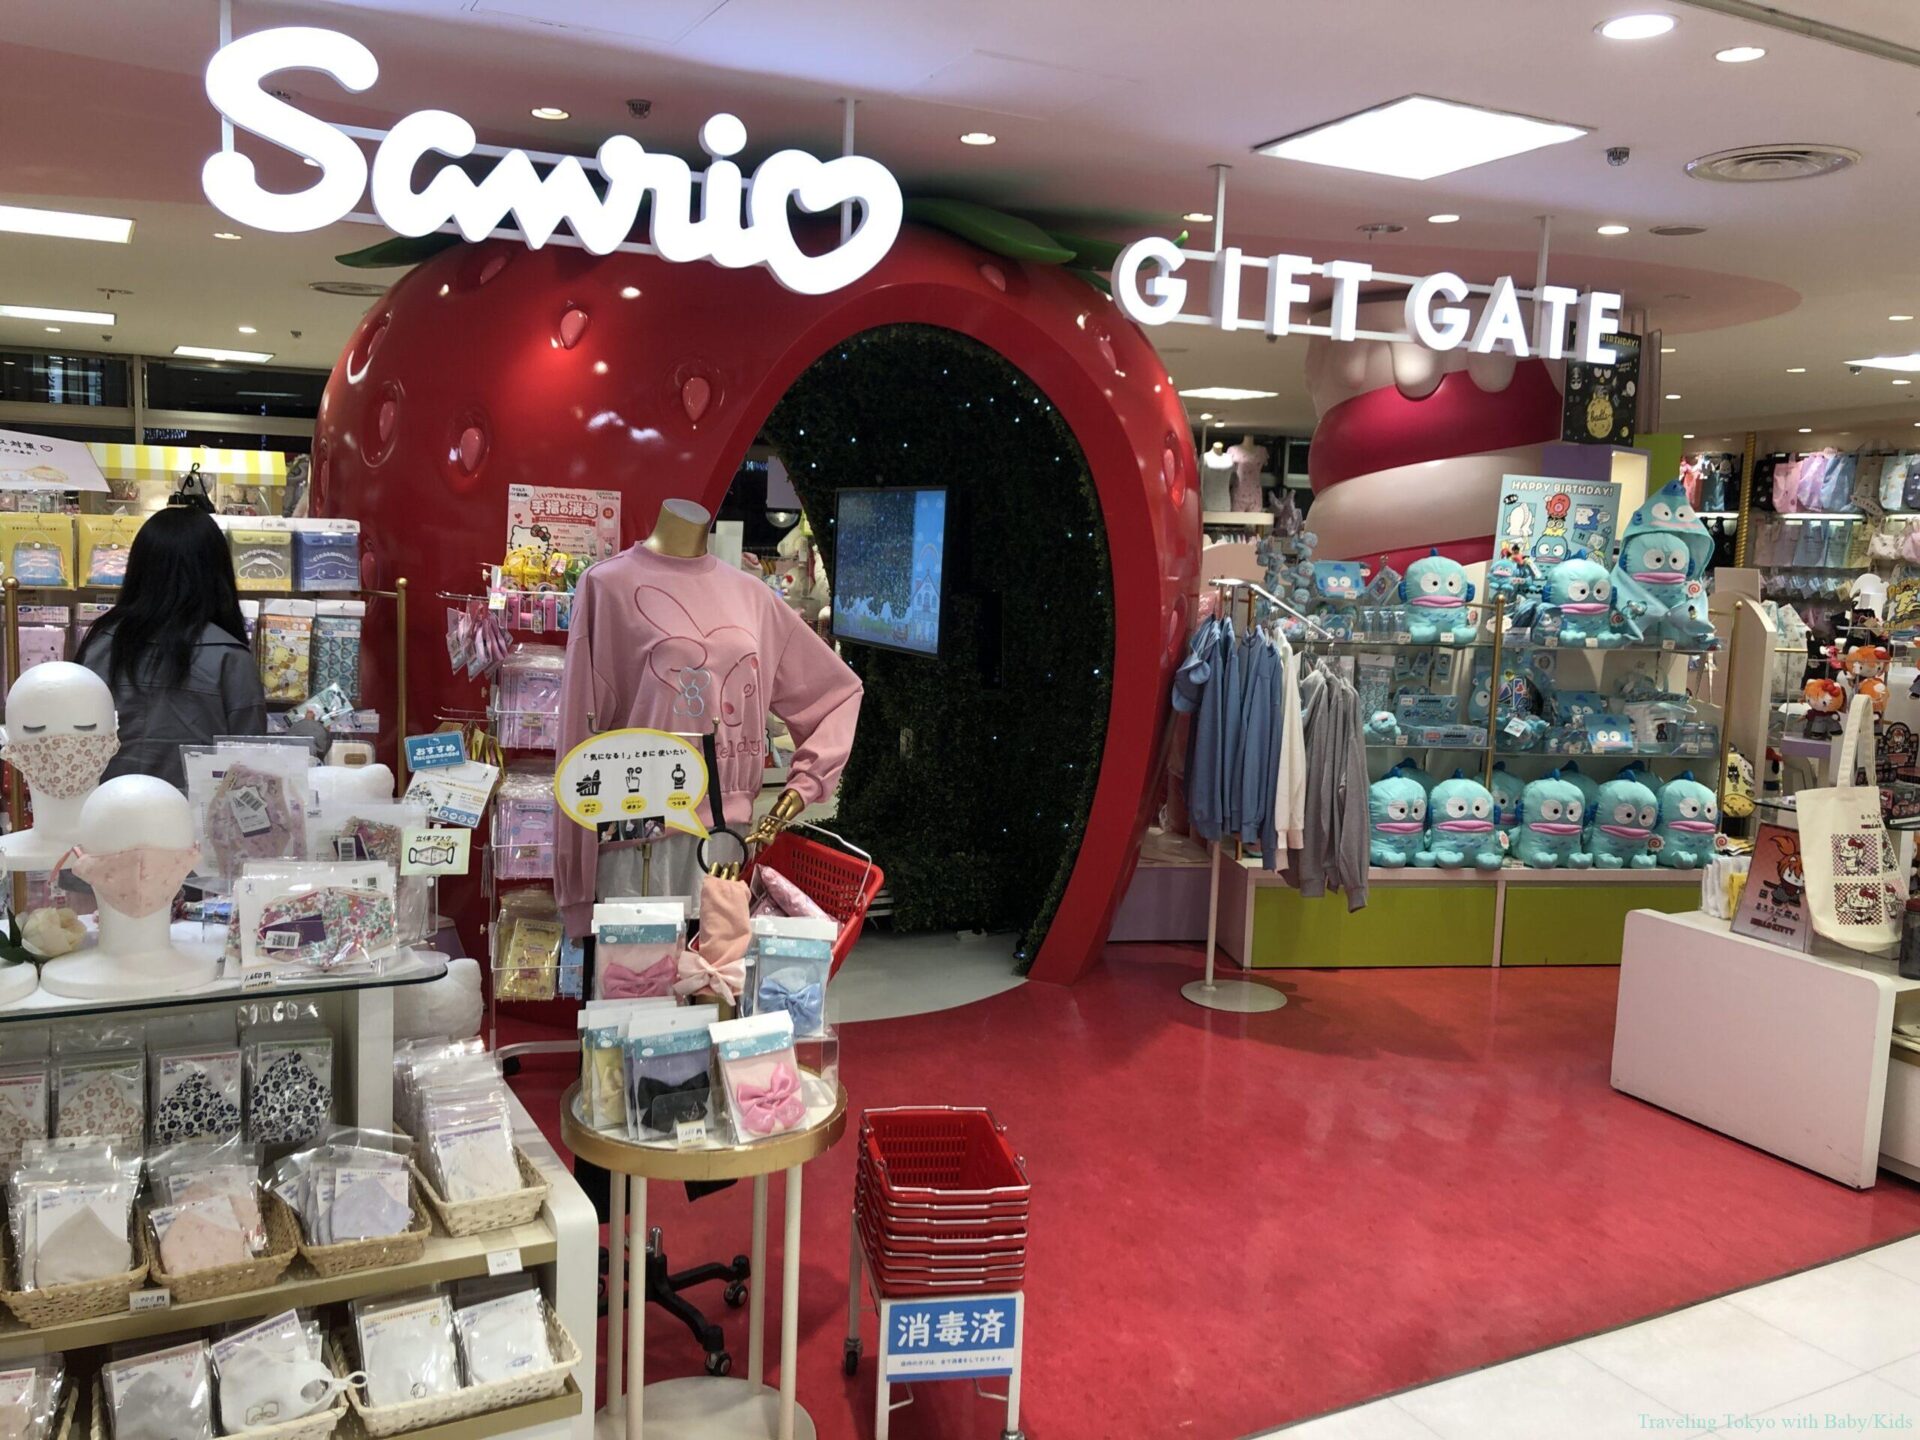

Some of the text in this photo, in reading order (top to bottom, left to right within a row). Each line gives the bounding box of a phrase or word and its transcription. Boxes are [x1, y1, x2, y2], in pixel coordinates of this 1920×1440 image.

[202, 26, 904, 295] Sanrio
[1112, 236, 1622, 365] GIFT GATE
[1511, 480, 1614, 497] HAPPY BIRTHDAY!
[530, 499, 598, 518] 手指の消毒
[413, 750, 460, 762] Recommended
[415, 743, 456, 757] おすすめ
[897, 1308, 1006, 1348] 消毒済
